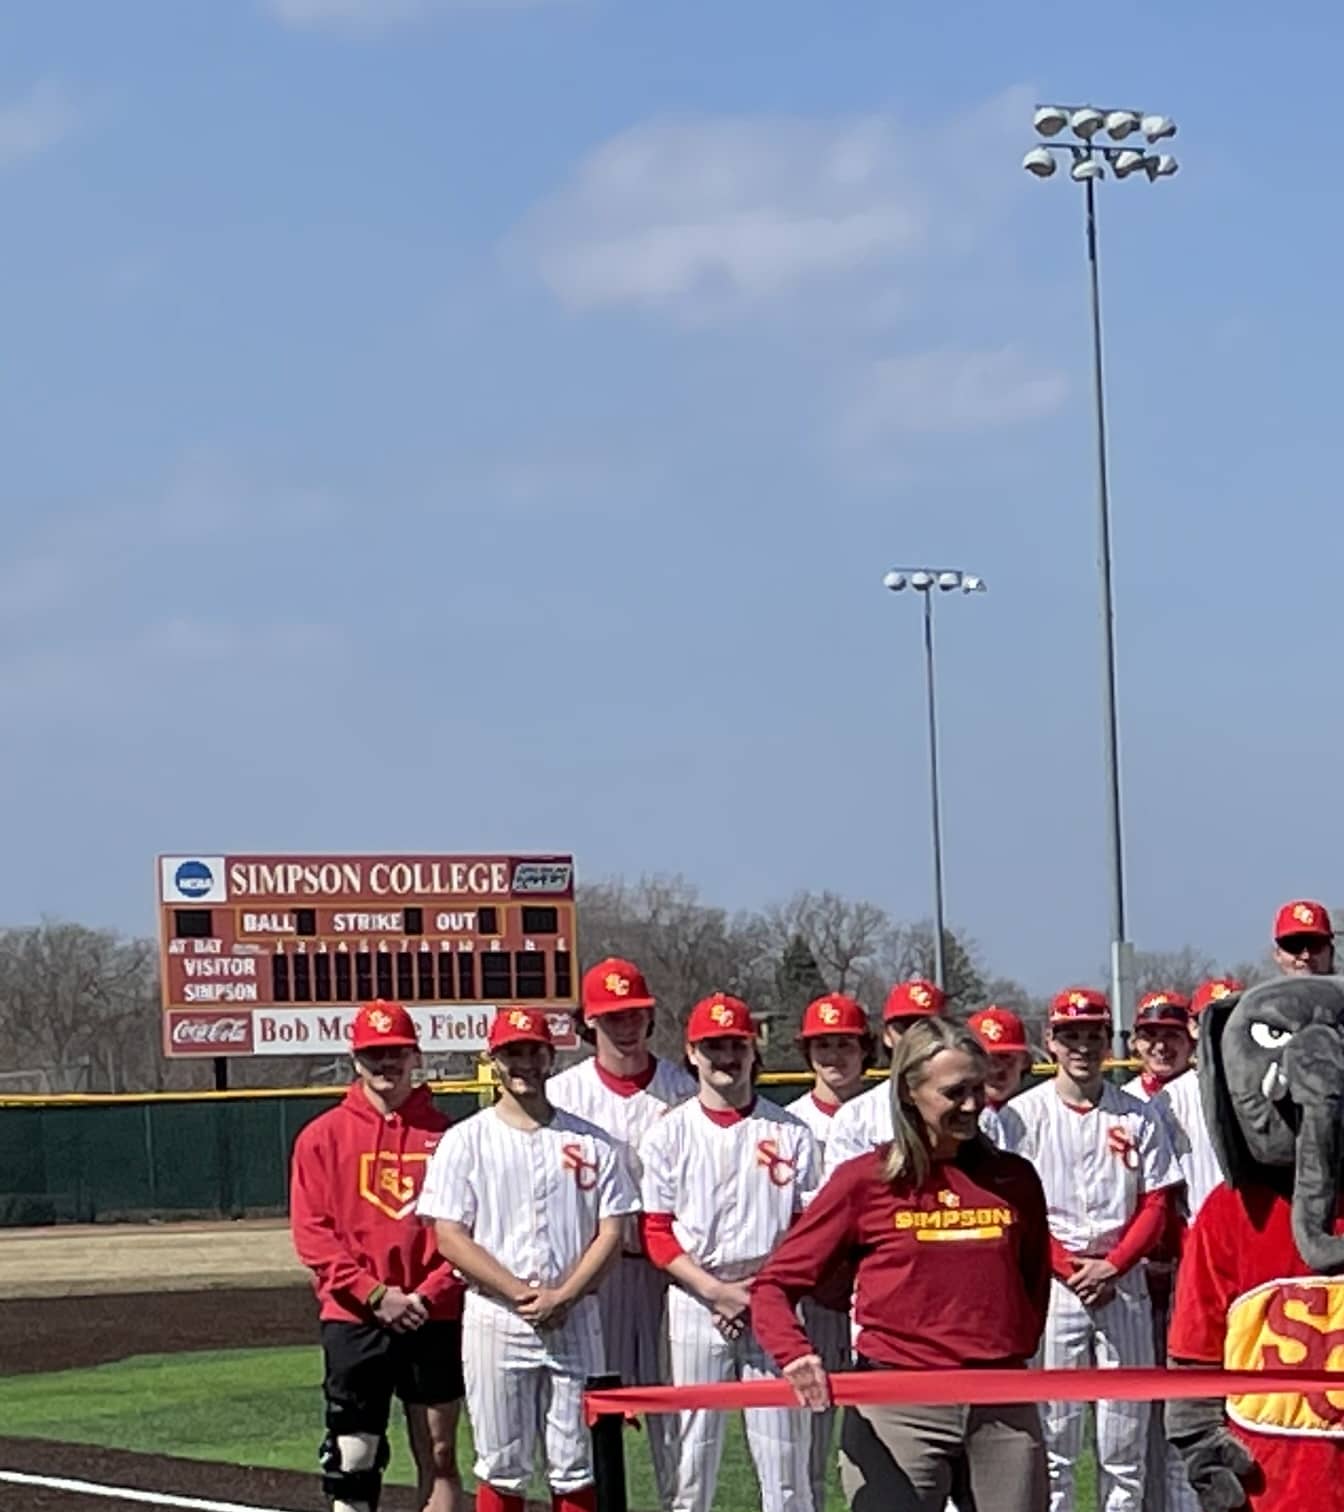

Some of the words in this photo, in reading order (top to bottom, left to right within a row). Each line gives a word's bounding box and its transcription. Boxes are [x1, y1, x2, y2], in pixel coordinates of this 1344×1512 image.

[230, 863, 361, 896] SIMPSON
[369, 862, 510, 895] COLLEGE
[243, 913, 295, 932] BALL
[333, 912, 403, 932] STRIKE
[436, 912, 476, 931] OUT
[169, 939, 186, 954] AT
[184, 958, 256, 977] VISITOR
[183, 983, 258, 1002] SIMPSON
[260, 1017, 309, 1042] Bob
[430, 1013, 488, 1040] Field
[1106, 1126, 1140, 1170] SC
[562, 1144, 598, 1190] SC
[759, 1140, 796, 1186] SC
[895, 1207, 1013, 1229] SIMPSON
